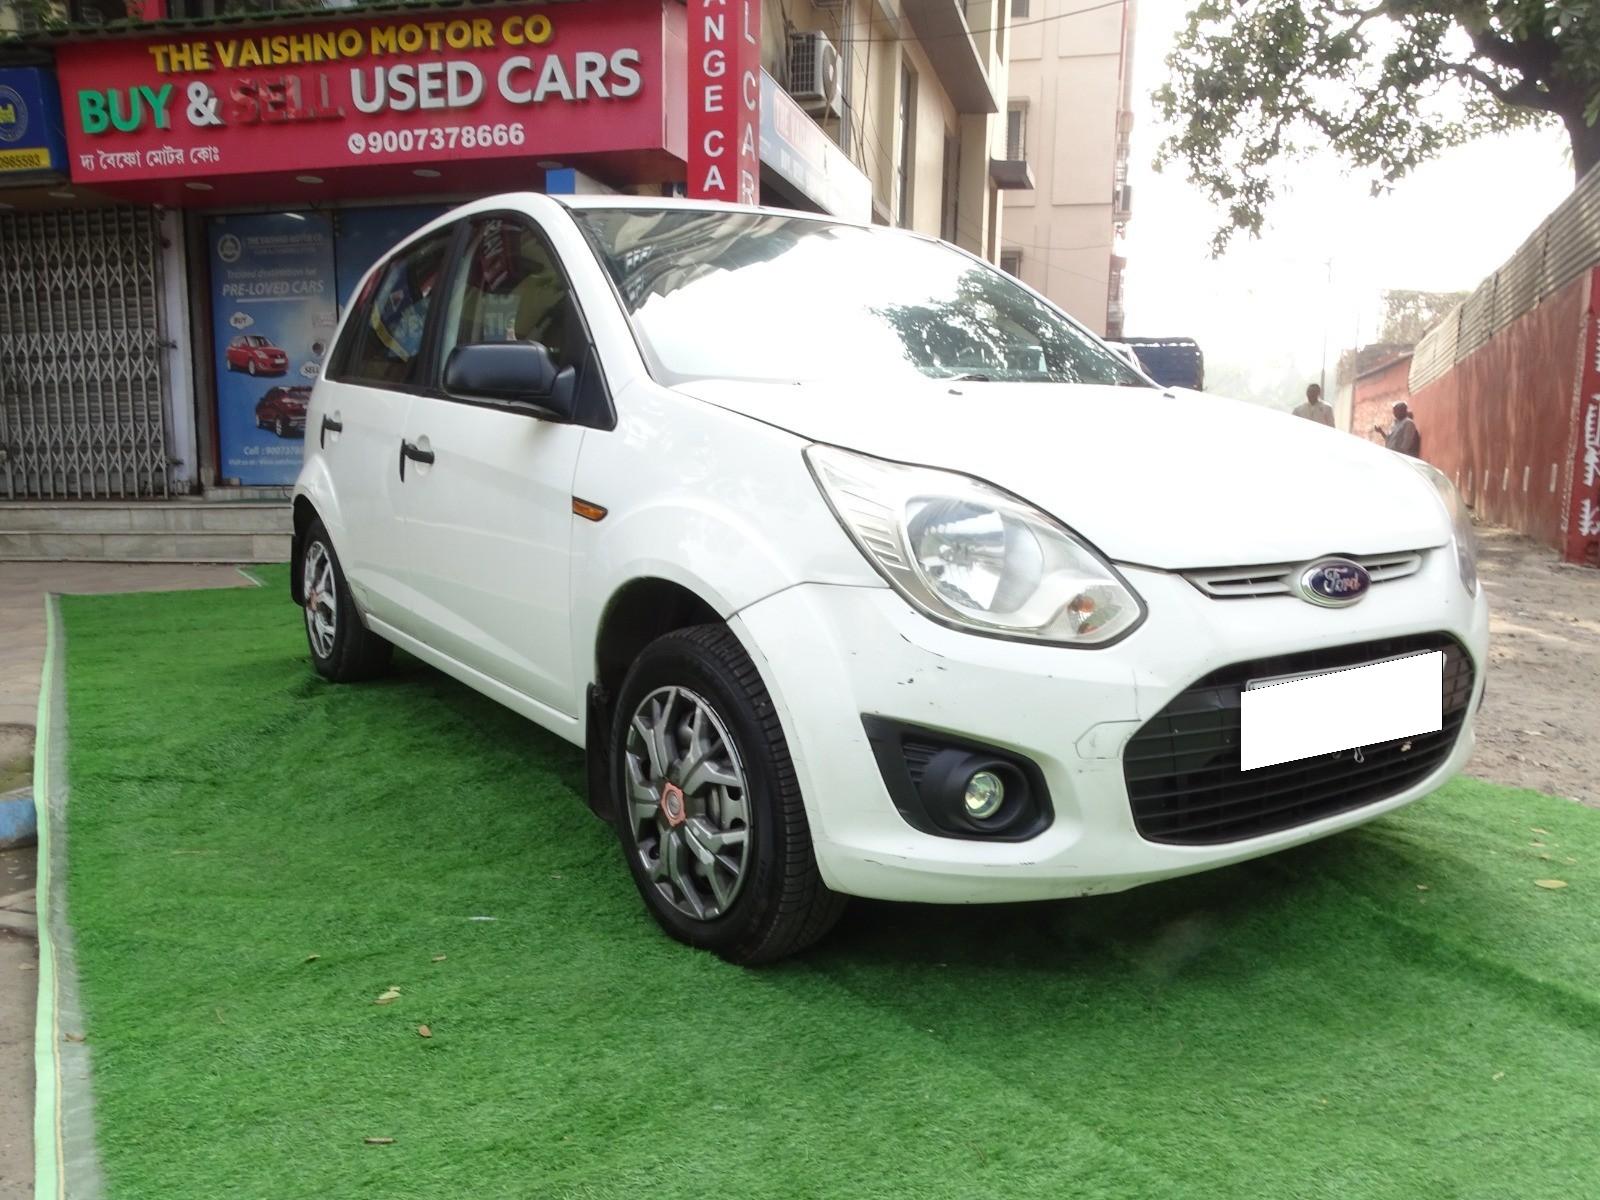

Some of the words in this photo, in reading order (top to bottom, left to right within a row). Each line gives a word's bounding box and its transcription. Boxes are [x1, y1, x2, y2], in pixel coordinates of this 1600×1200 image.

[149, 40, 211, 73] THE
[215, 28, 364, 68] VAISHNO
[371, 18, 496, 56] MOTOR
[501, 14, 554, 46] CO
[77, 82, 174, 134] BUY
[186, 81, 225, 127] &
[350, 60, 488, 114] USED
[497, 48, 643, 104] CARS
[366, 122, 526, 153] 9007378666
[222, 280, 290, 297] PRE-LOVED
[291, 279, 325, 296] CARS
[233, 316, 248, 325] BUY
[1323, 566, 1362, 594] Ford
